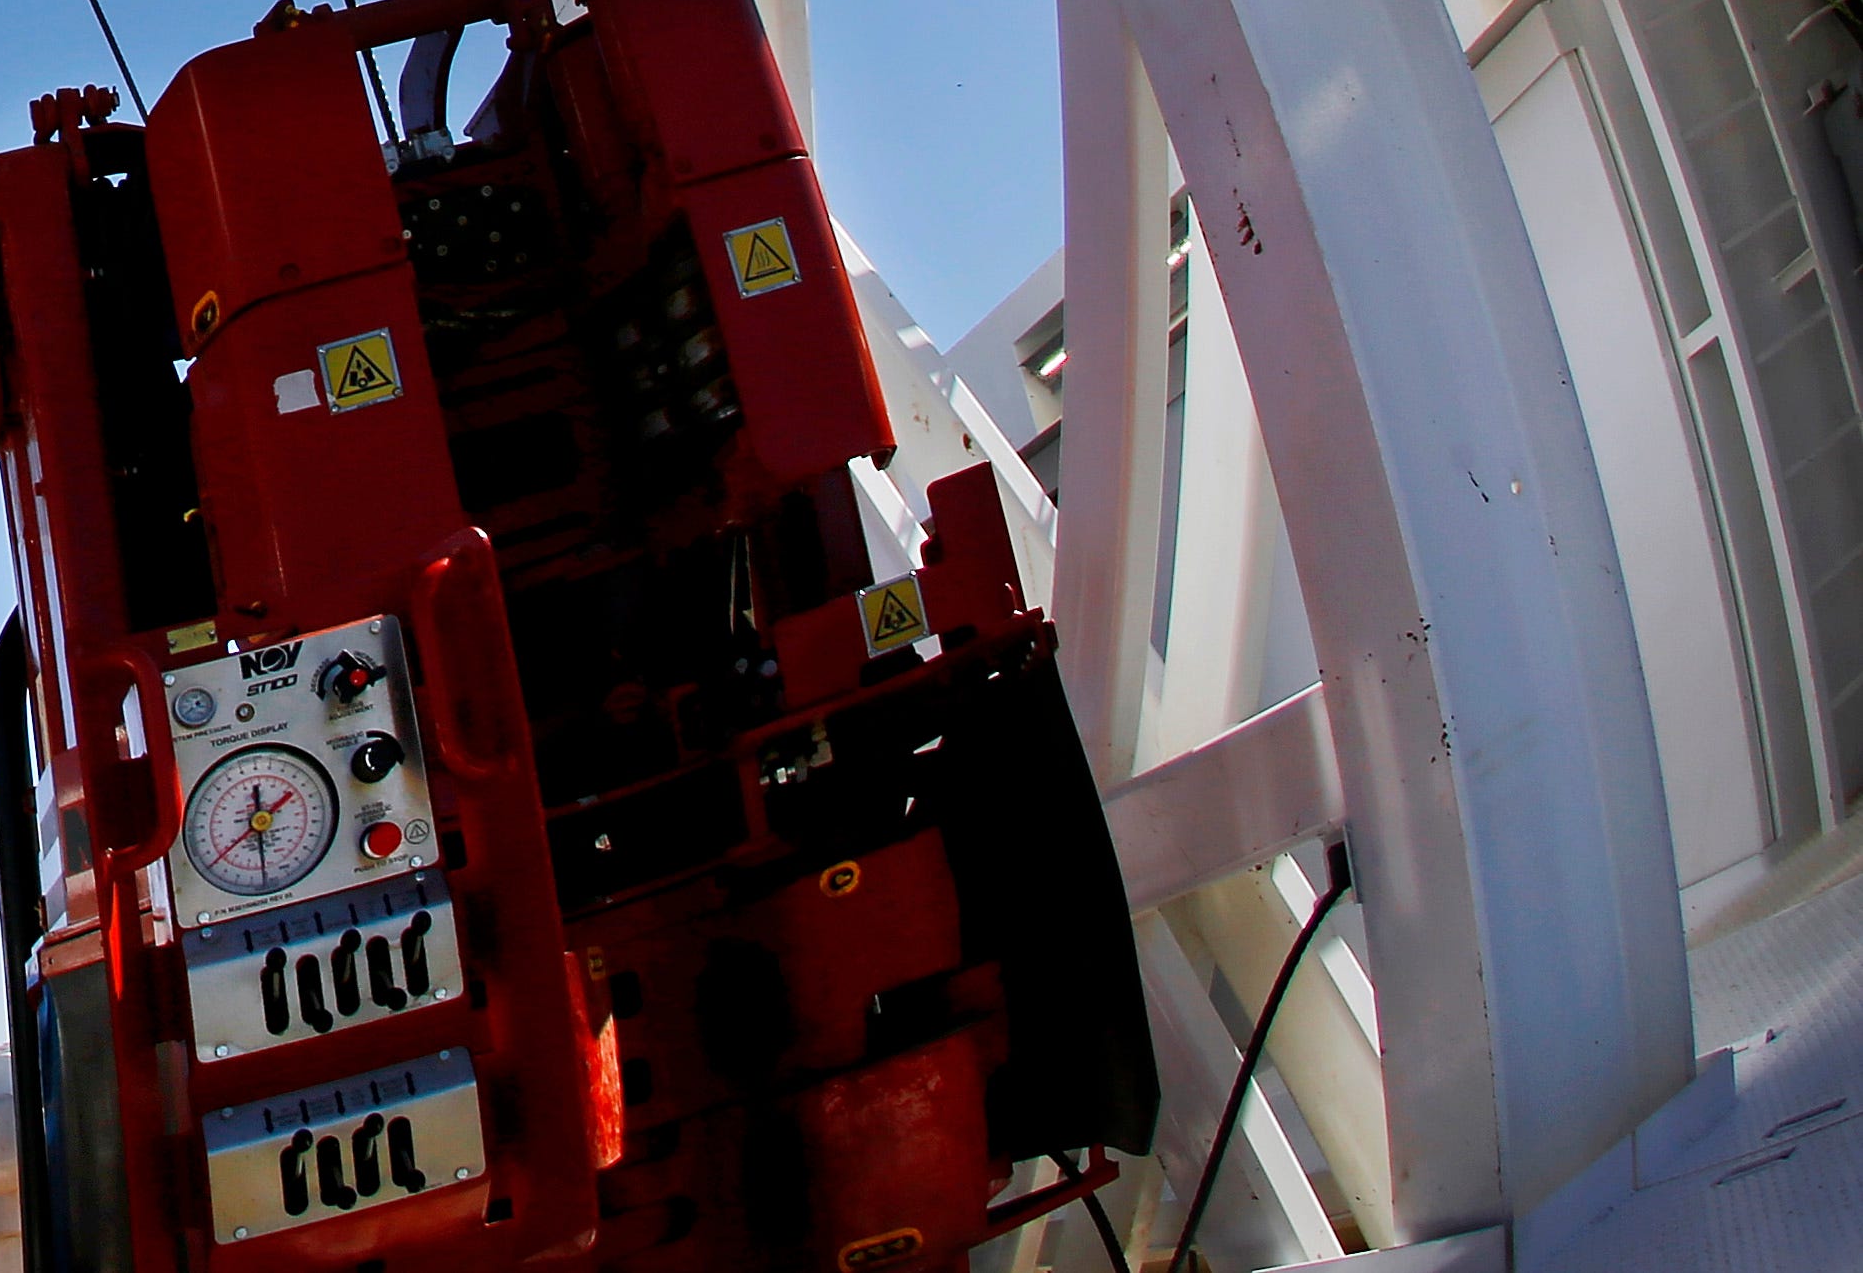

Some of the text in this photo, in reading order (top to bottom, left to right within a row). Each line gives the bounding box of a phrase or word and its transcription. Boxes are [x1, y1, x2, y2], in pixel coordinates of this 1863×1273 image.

[239, 640, 305, 681] NOV
[210, 722, 289, 747] TORQUE DISPLAY
